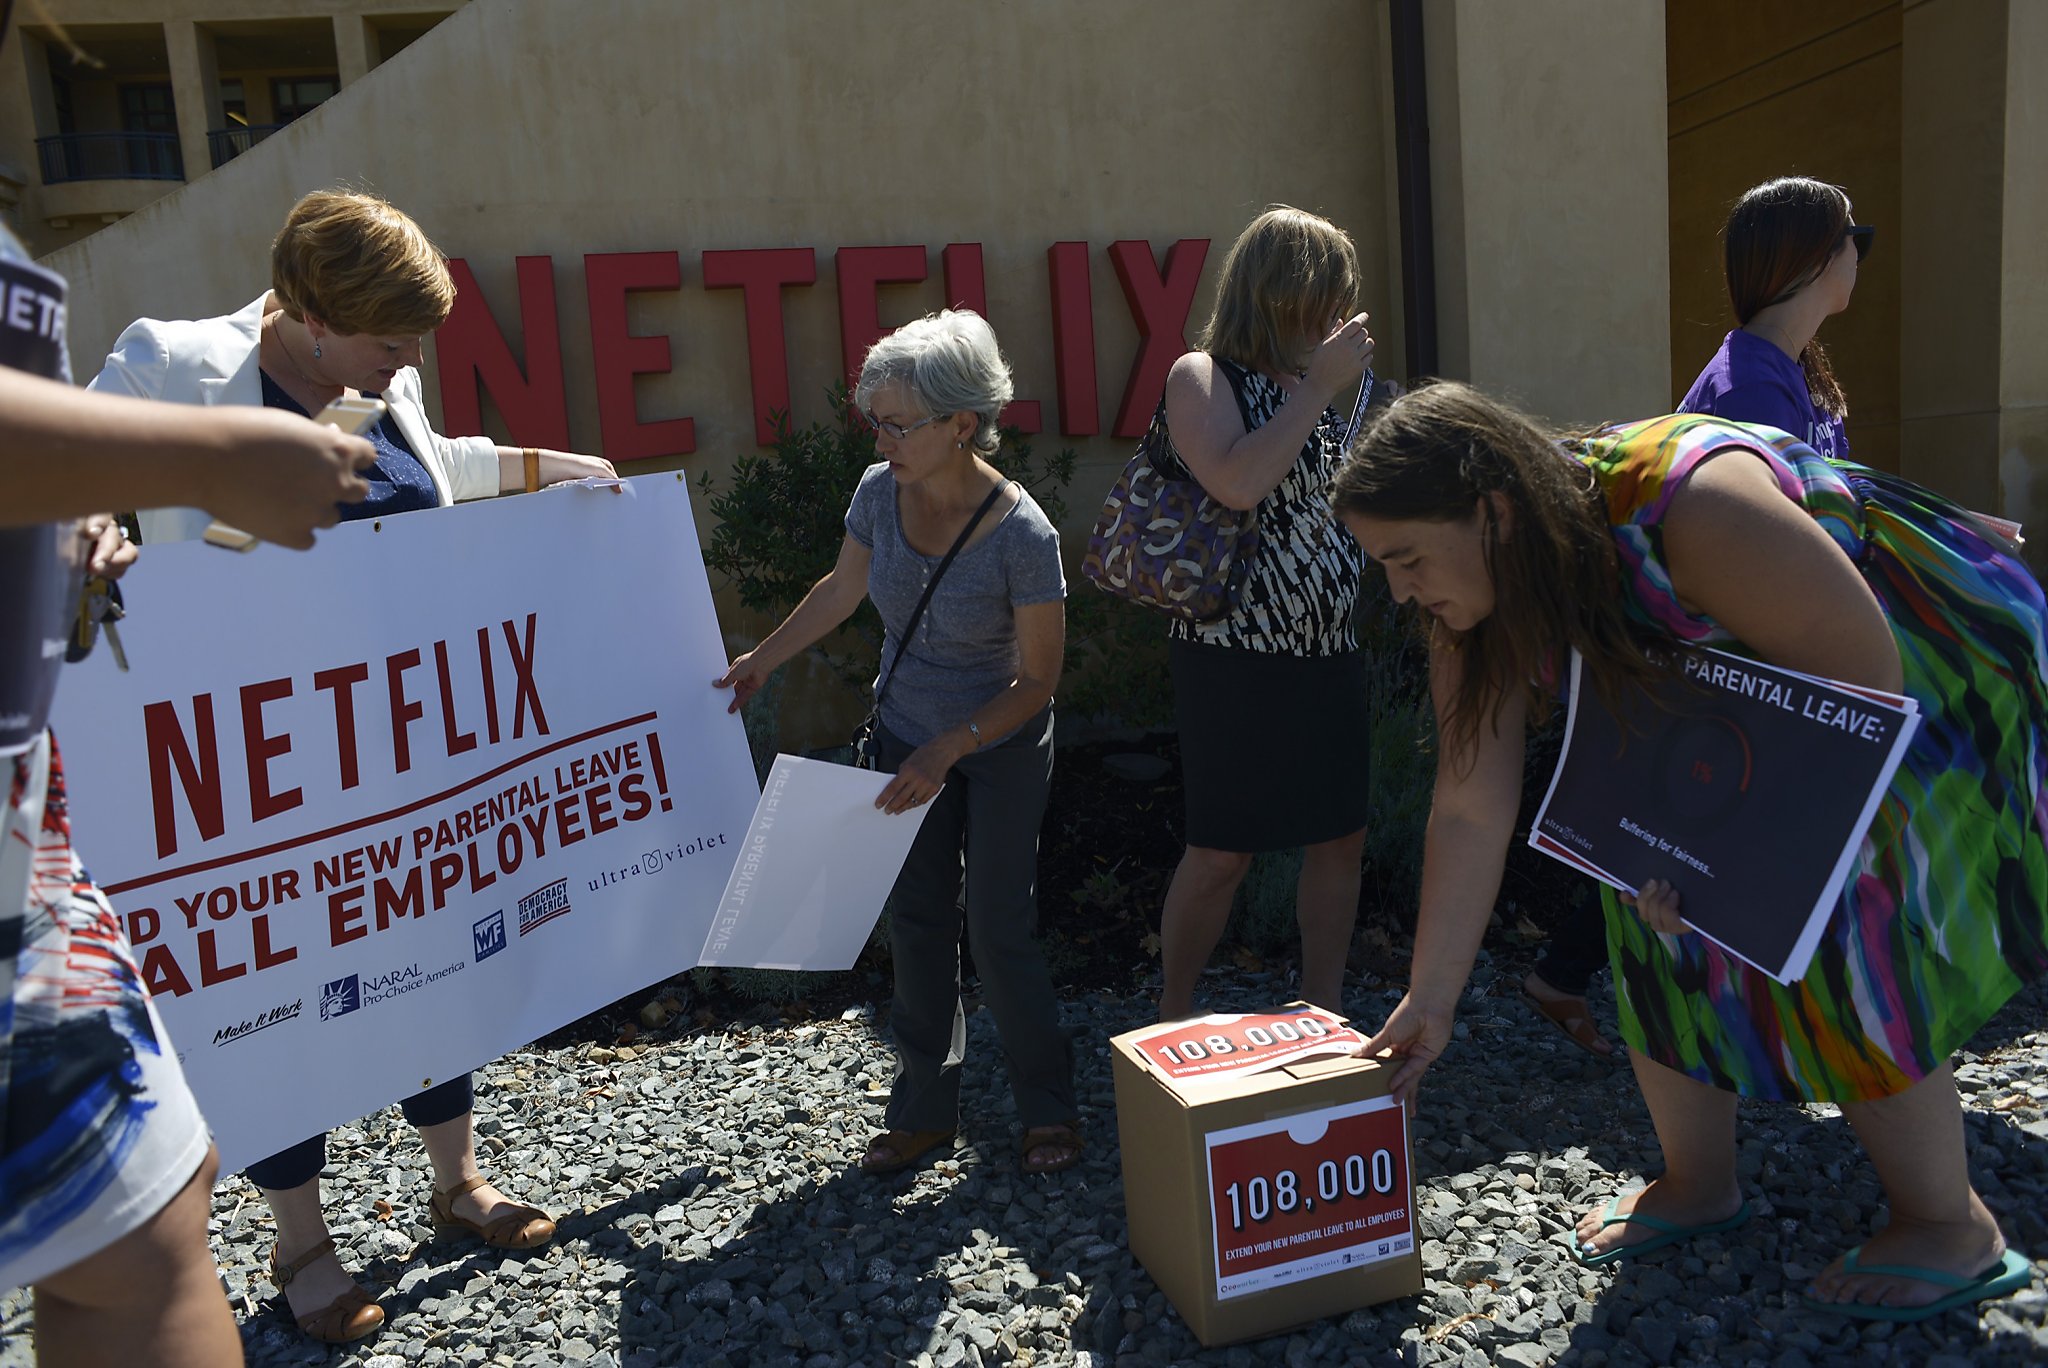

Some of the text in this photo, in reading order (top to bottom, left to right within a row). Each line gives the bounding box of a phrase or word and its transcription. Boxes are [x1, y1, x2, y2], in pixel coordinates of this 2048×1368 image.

[435, 238, 1211, 463] NETFLIX
[1684, 655, 1795, 711] PARENTAL
[1802, 695, 1886, 743] LEAVE:
[144, 613, 550, 860] NETFLIX
[174, 869, 301, 929] YOUR
[313, 836, 403, 893] NEW
[413, 776, 550, 860] PARENTAL
[555, 741, 642, 795] LEAVE
[1619, 817, 1657, 847] Buffering
[1657, 838, 1673, 852] for
[141, 732, 673, 998] ALL EMPLOYEES!
[518, 881, 568, 916] DEMOCRACY
[519, 893, 569, 924] FOR AMERICA
[475, 922, 502, 954] WF
[363, 963, 423, 995] NARAL
[364, 961, 465, 1007] Pro-Choice America
[212, 998, 303, 1044] Make It Work
[1158, 1016, 1330, 1065] 108,000
[1226, 1148, 1394, 1230] 108,000
[1225, 1207, 1405, 1261] EXTEND YOUR NEW PARENTAL LEAVE TO ALL EMPLOYEES
